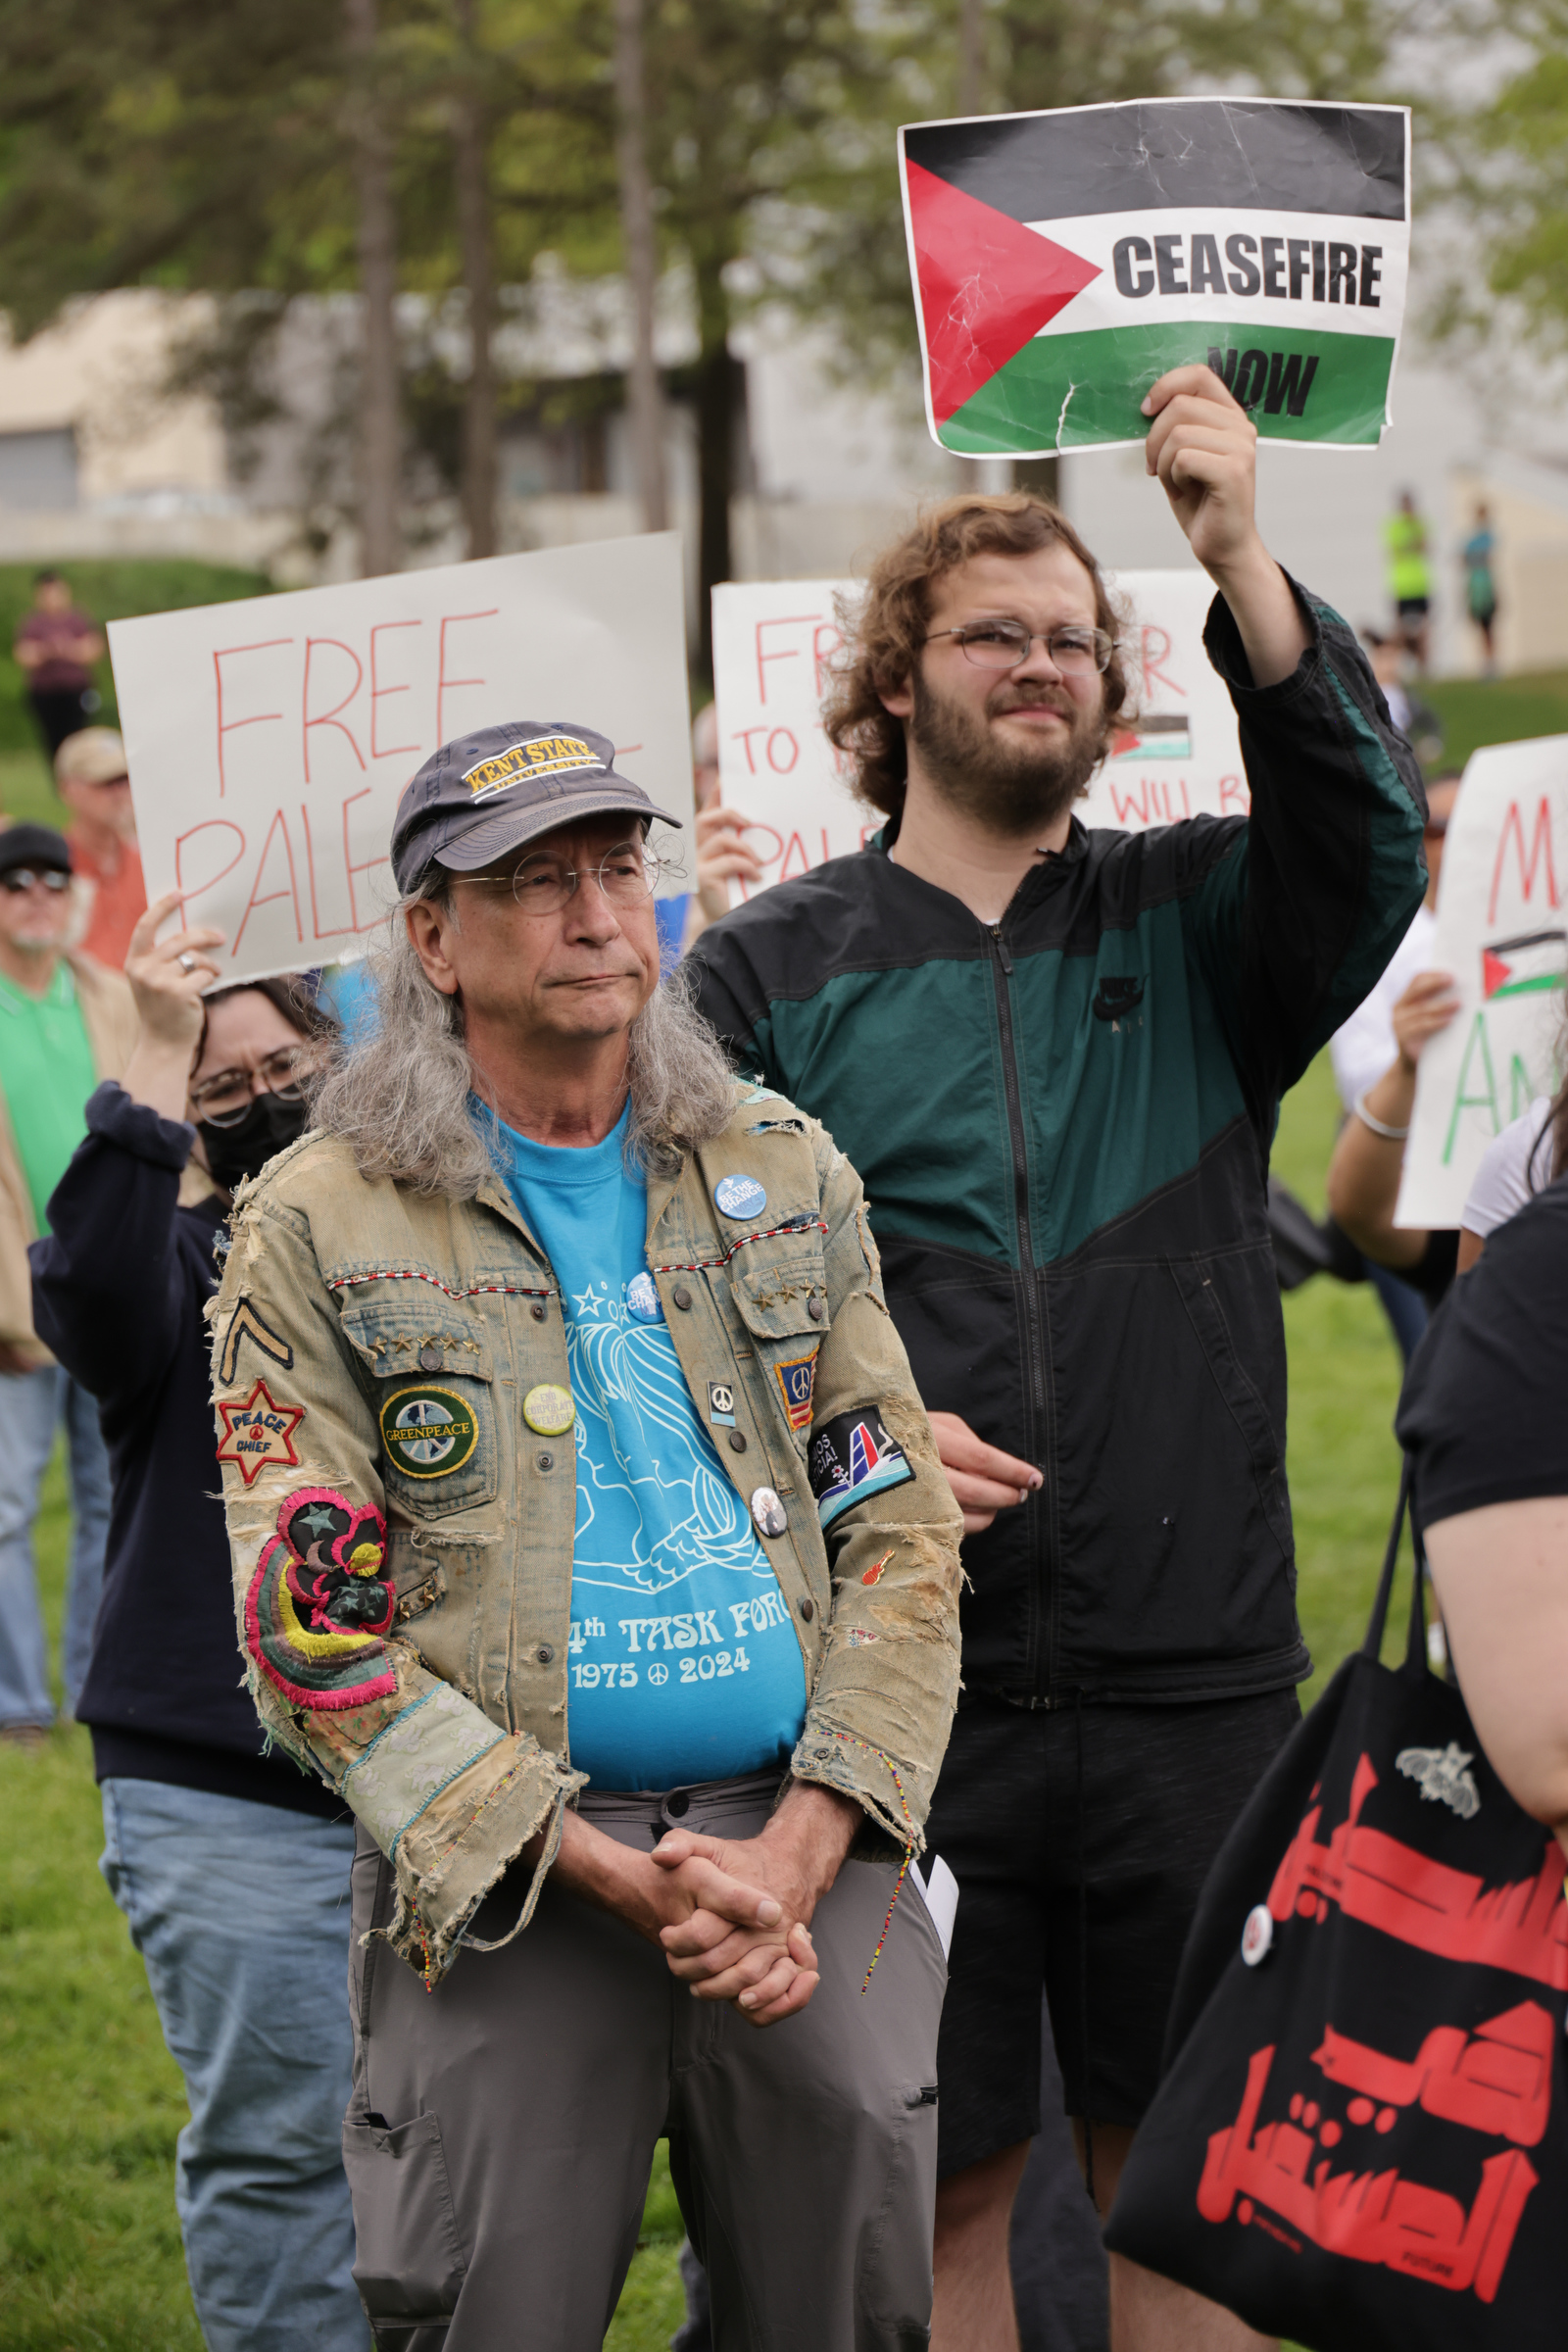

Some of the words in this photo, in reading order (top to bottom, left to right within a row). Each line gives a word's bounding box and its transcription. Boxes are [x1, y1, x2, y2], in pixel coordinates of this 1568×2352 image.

[1112, 233, 1383, 308] CEASEFIRE
[1207, 346, 1320, 417] NOW
[755, 614, 845, 707] FR
[213, 609, 499, 798] FREE
[731, 725, 800, 776] TO
[465, 748, 527, 794] KENT
[525, 739, 597, 763] STATE
[493, 759, 591, 790] UNIVERSITY
[1108, 777, 1192, 825] WILL
[1218, 774, 1251, 817] B
[174, 787, 392, 957] PALE
[718, 1190, 734, 1204] BE
[731, 1179, 753, 1196] THE
[719, 1183, 764, 1213] CHANGE
[627, 1294, 662, 1310] CHAN
[630, 1288, 646, 1300] BE
[525, 1399, 575, 1416] CORPORATE
[539, 1392, 557, 1402] END
[231, 1410, 288, 1435] PEACE
[385, 1421, 470, 1443] GREENPEACE
[532, 1412, 572, 1426] WELFARE
[236, 1440, 272, 1453] CHIEF
[618, 1609, 724, 1653] TASK
[570, 1662, 639, 1689] 1975
[678, 1646, 751, 1685] 2024
